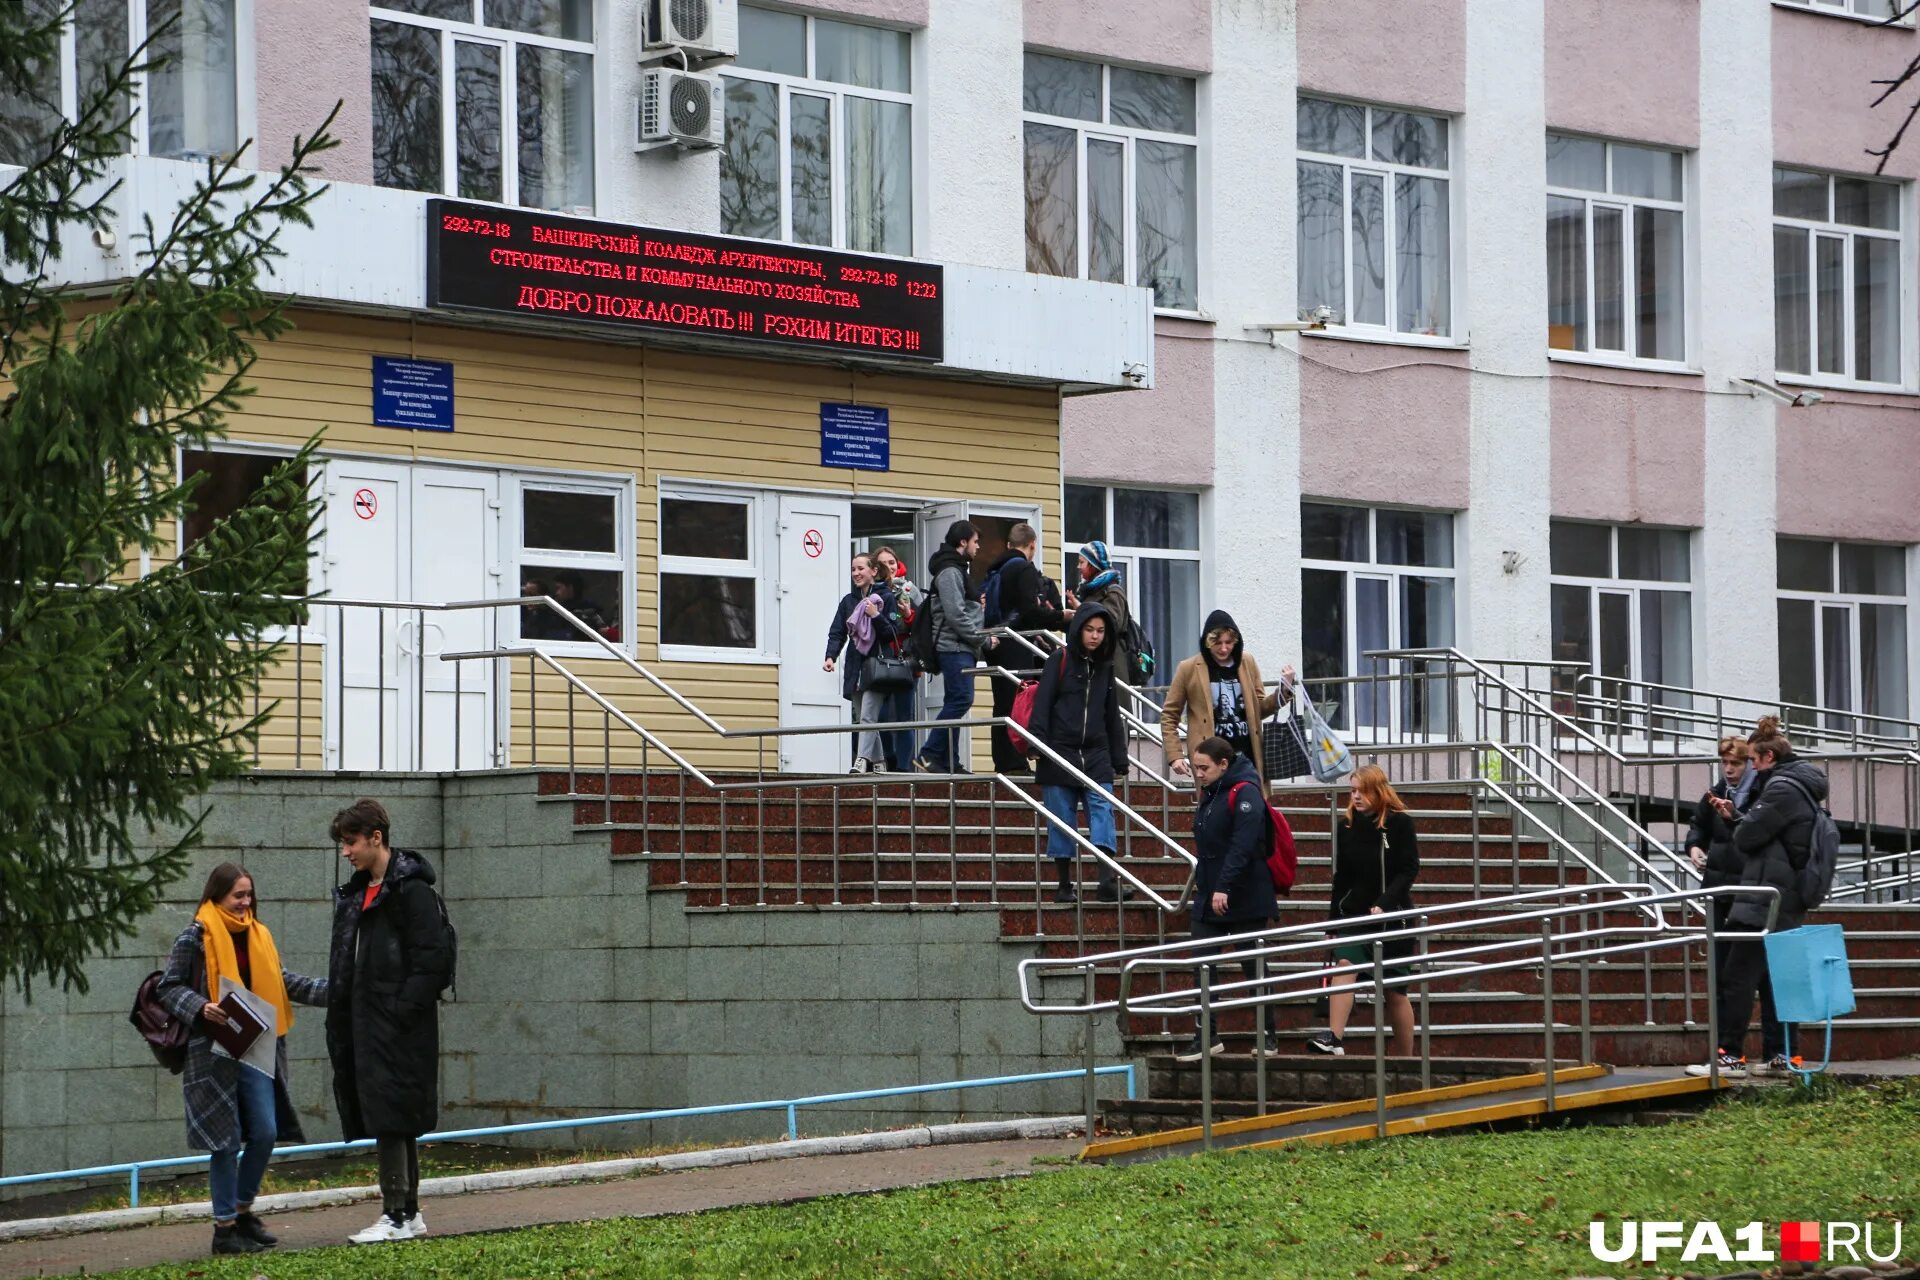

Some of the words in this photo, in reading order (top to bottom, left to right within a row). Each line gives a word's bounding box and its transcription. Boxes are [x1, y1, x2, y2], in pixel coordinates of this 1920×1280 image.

[443, 216, 511, 238] 292-72-18
[532, 226, 640, 255] БАШКИРСКИЙ
[644, 241, 717, 265] КОЛЛЕДЖ
[720, 250, 827, 281] АРХИТЕКТУРЫ,
[489, 249, 623, 280] СТРОИТЕЛЬСТВА
[625, 266, 637, 281] И
[641, 267, 772, 297] КОММУНАЛЬНОГО
[774, 283, 861, 308] ХОЗЯЙСТВА
[840, 267, 898, 287] 292-72-18
[906, 281, 937, 298] 12:22
[517, 286, 591, 313] ДОБРО
[764, 314, 831, 341] РЭХИМ
